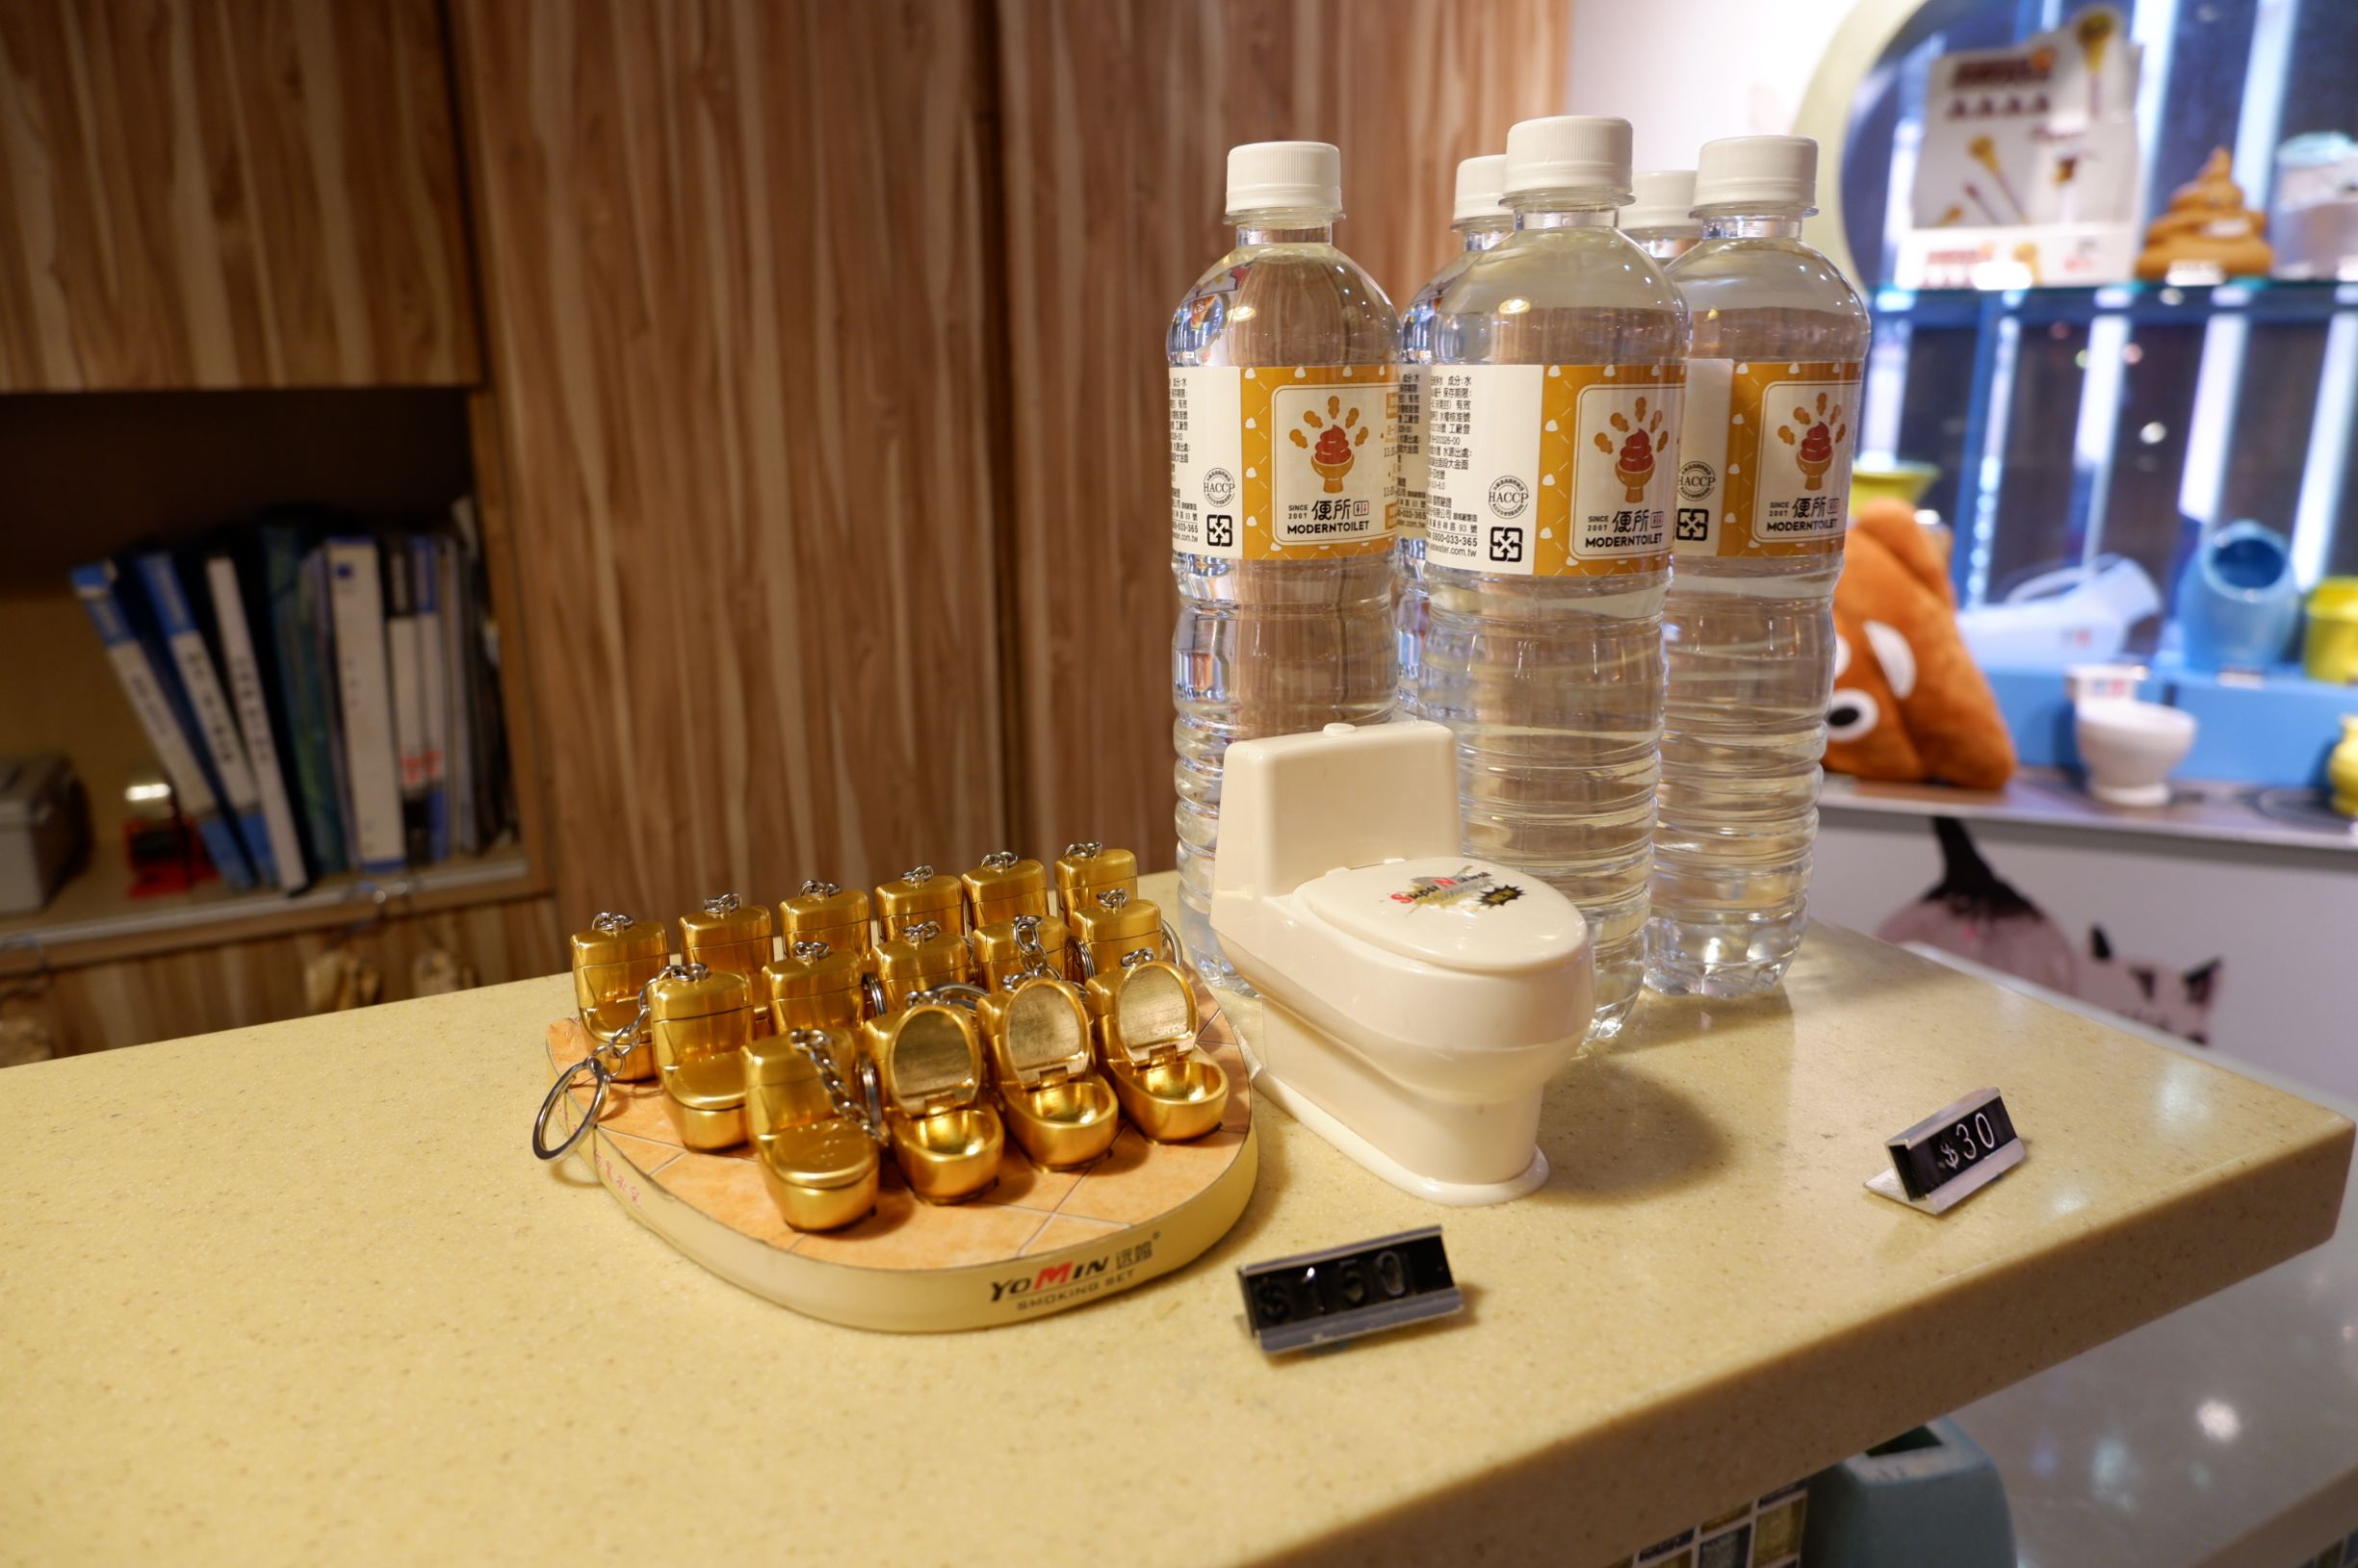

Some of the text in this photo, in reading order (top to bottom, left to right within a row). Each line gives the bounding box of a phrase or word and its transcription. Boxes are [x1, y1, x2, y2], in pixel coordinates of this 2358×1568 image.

[1204, 482, 1235, 494] HACCP
[1489, 491, 1529, 503] HACCP
[1770, 501, 1790, 509] SINCE
[1288, 503, 1309, 512] SINCE
[1311, 499, 1351, 521] 便所
[1792, 496, 1827, 519] 便所
[1287, 520, 1370, 535] MODERNTOILET
[1612, 509, 1649, 533] 便所
[1767, 518, 1837, 532] MODERNTOILET
[1585, 532, 1663, 549] MODERNTOILET
[1940, 1113, 1995, 1170] $30
[1017, 1269, 1135, 1310] SMOKING SET
[1254, 1250, 1406, 1324] $150
